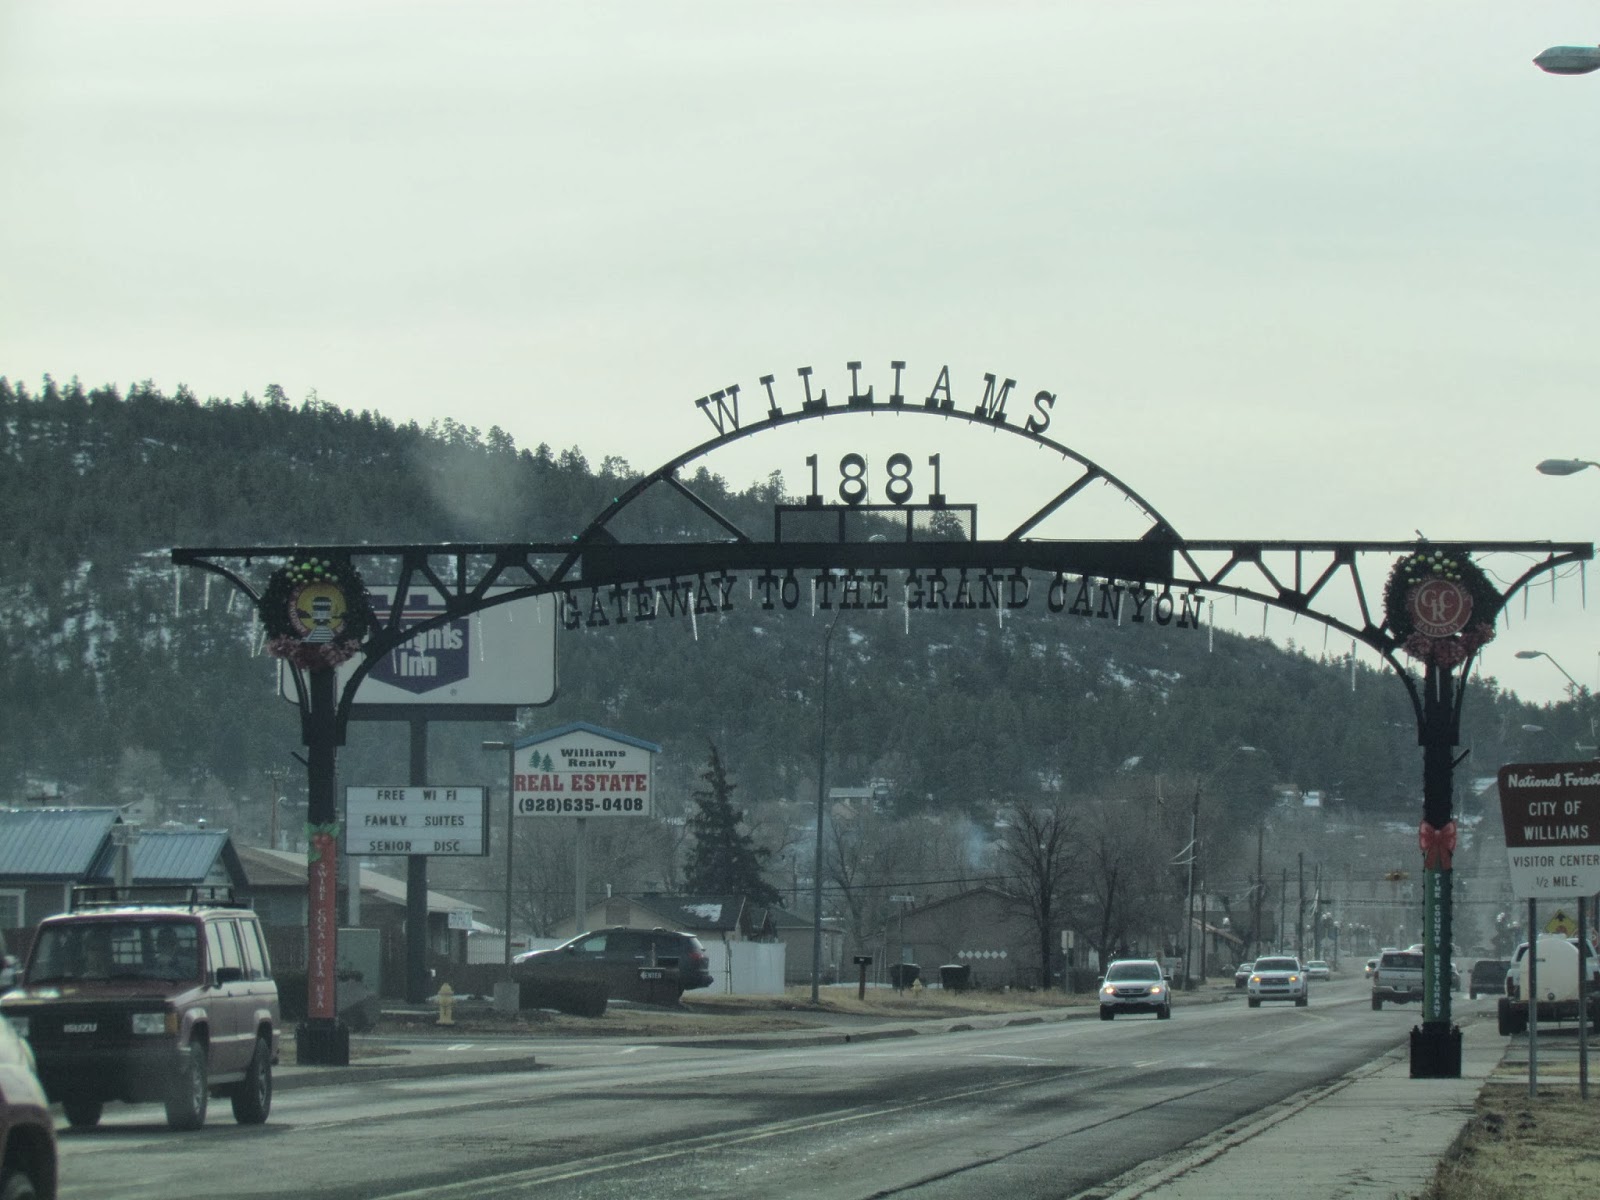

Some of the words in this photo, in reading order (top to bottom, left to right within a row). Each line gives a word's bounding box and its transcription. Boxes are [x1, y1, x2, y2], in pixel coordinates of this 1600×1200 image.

[694, 361, 1057, 436] WILLIAMS
[806, 452, 946, 506] 1881
[560, 575, 737, 630] GATEWAY
[758, 575, 799, 610] TO
[816, 574, 889, 610] THE
[906, 574, 1030, 610] GRAND
[1048, 579, 1205, 630] CANYON
[400, 652, 437, 677] Inn
[560, 748, 626, 758] Williams
[568, 758, 616, 769] Realty
[514, 774, 564, 792] REAL
[571, 774, 647, 792] ESTATE
[1508, 773, 1562, 788] National
[1564, 772, 1600, 787] Forest
[377, 789, 406, 800] FREE
[518, 797, 643, 814] (928)635-0408
[1528, 801, 1557, 816] CITY
[1564, 800, 1582, 815] OF
[364, 815, 407, 826] FAMILY
[425, 815, 465, 826] SUITES
[1524, 825, 1589, 840] WILLIAMS
[369, 841, 412, 851] SENIOR
[434, 841, 460, 851] DISC
[1513, 856, 1554, 867] VISITOR
[1559, 854, 1600, 866] CENTER
[1536, 876, 1549, 888] 1/2
[1552, 875, 1578, 887] MILE
[316, 985, 325, 1008] USA
[63, 1022, 98, 1033] ISUZU
